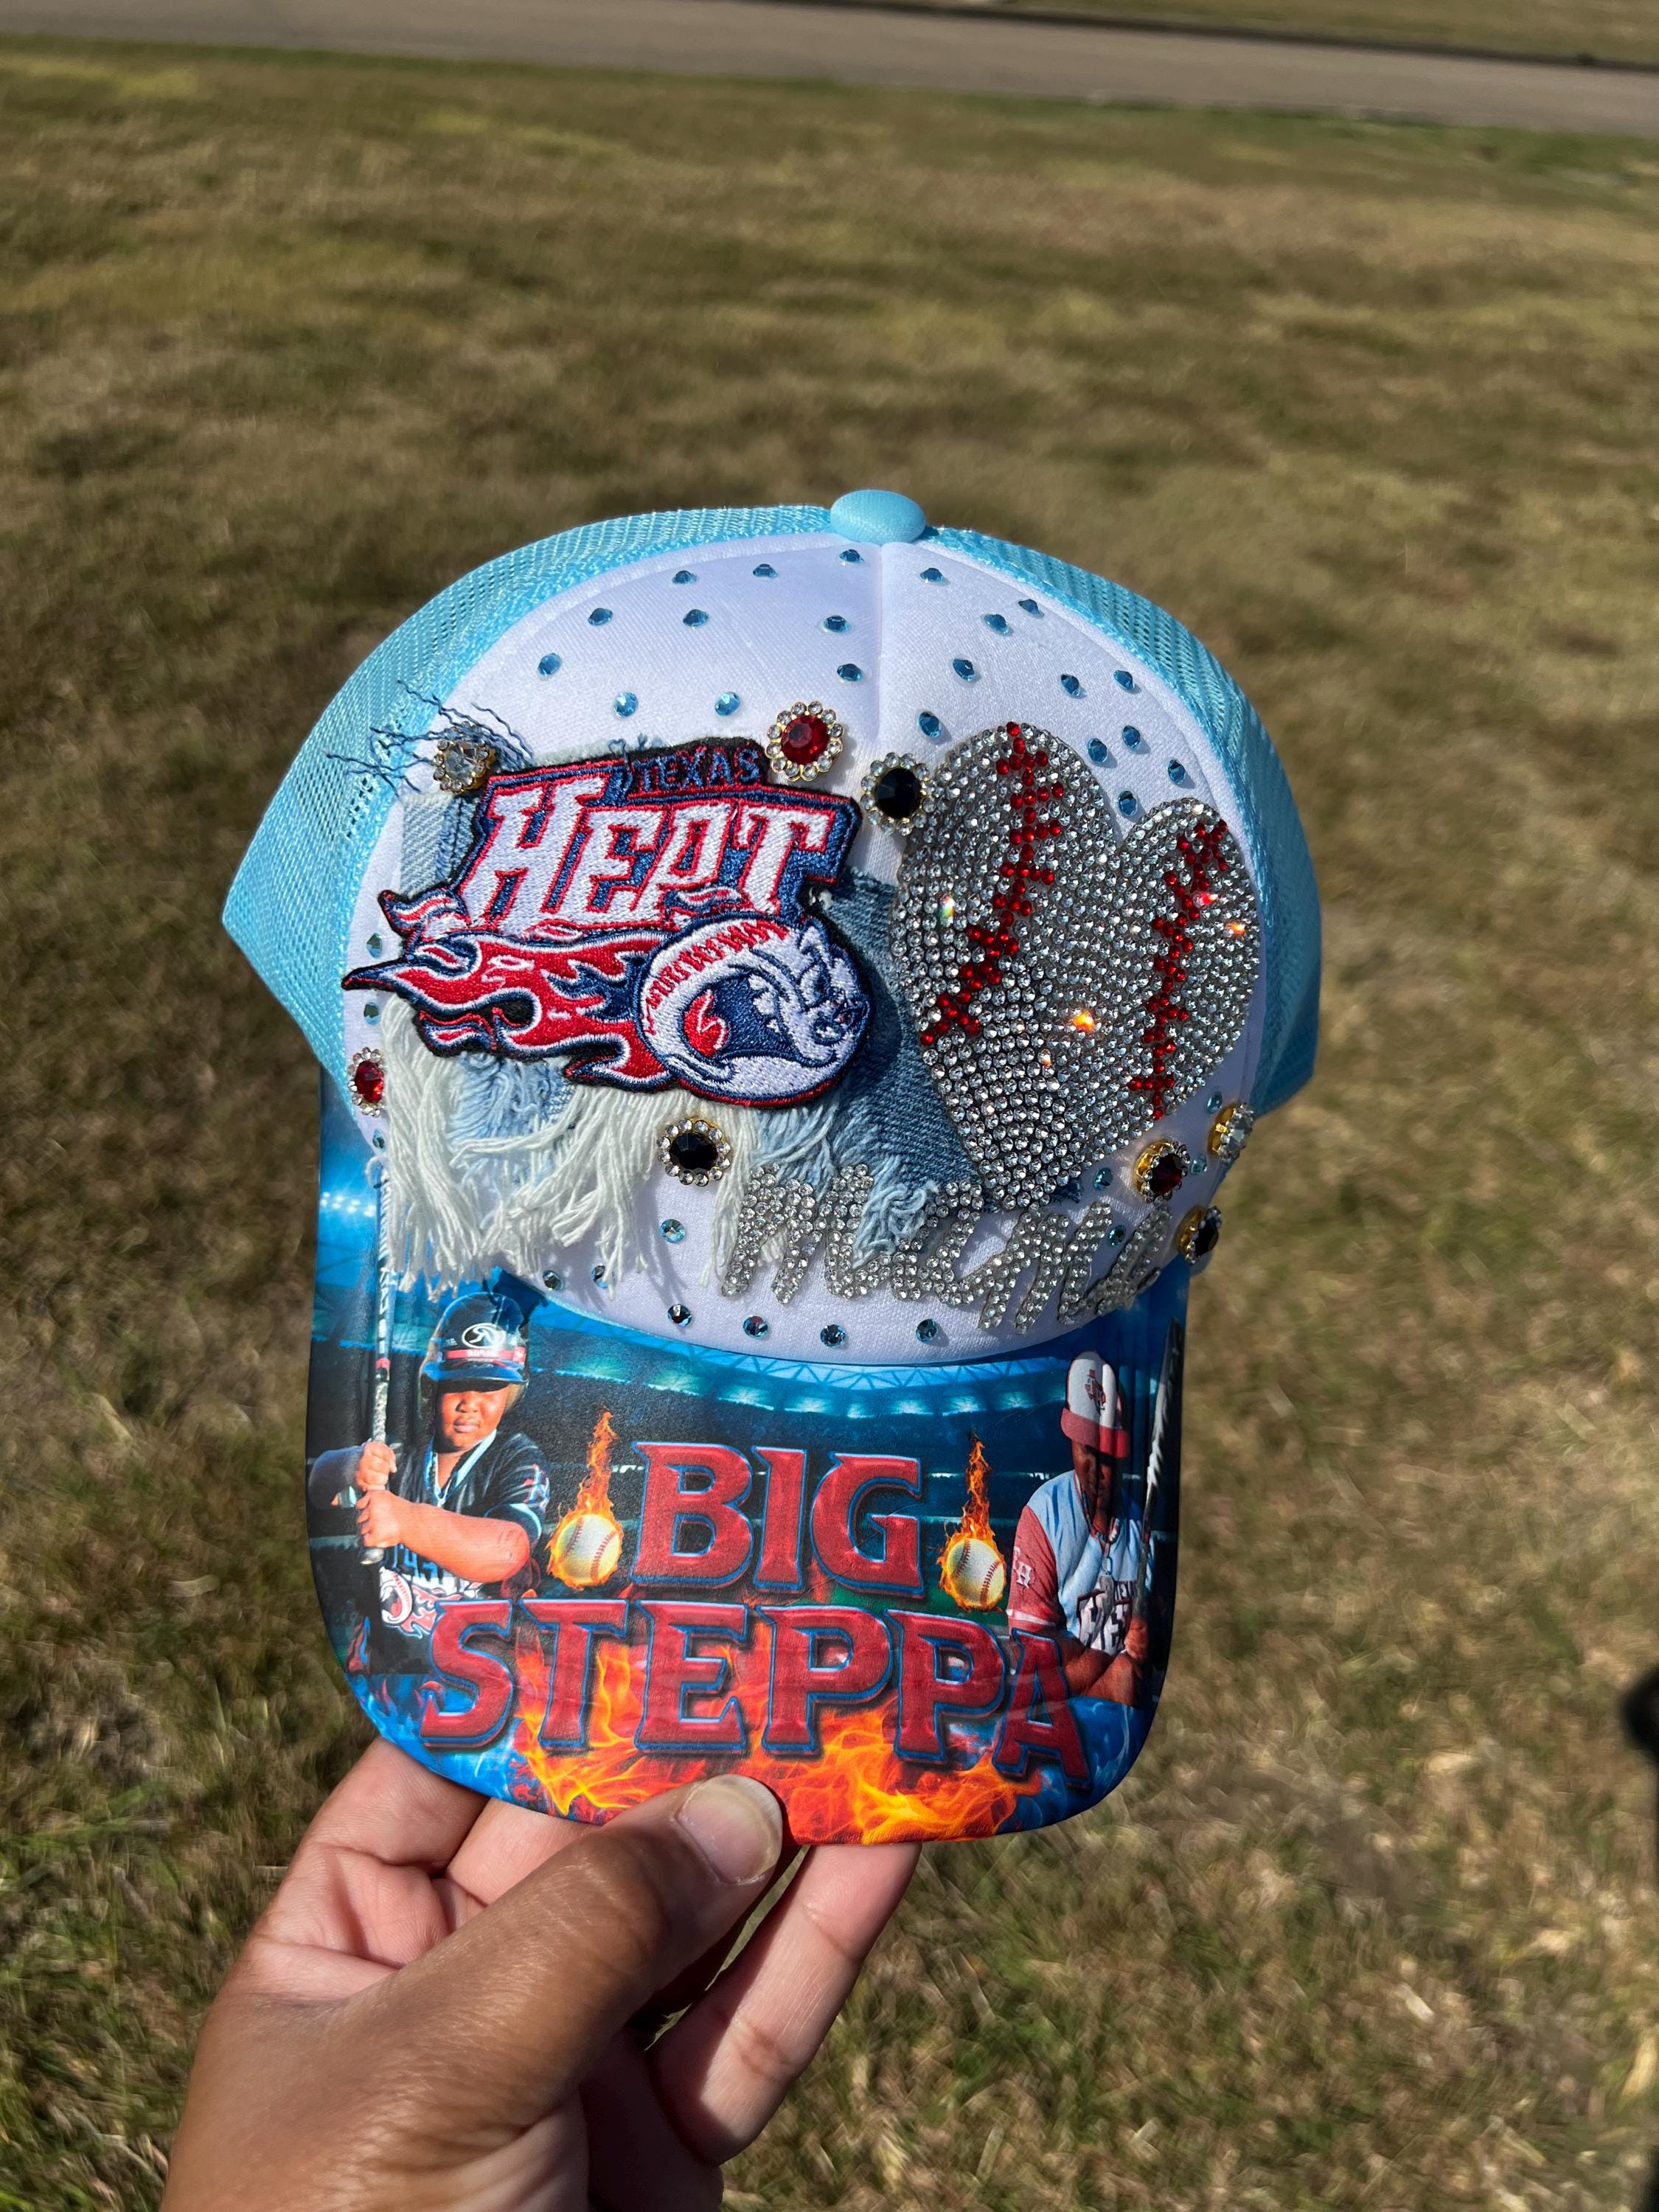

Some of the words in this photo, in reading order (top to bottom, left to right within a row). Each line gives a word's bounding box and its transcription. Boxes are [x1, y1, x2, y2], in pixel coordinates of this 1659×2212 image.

[632, 745, 761, 792] TEXAS
[459, 776, 838, 935] HEAT
[630, 1441, 927, 1598] BIG
[419, 1598, 1091, 1789] STEPPA
